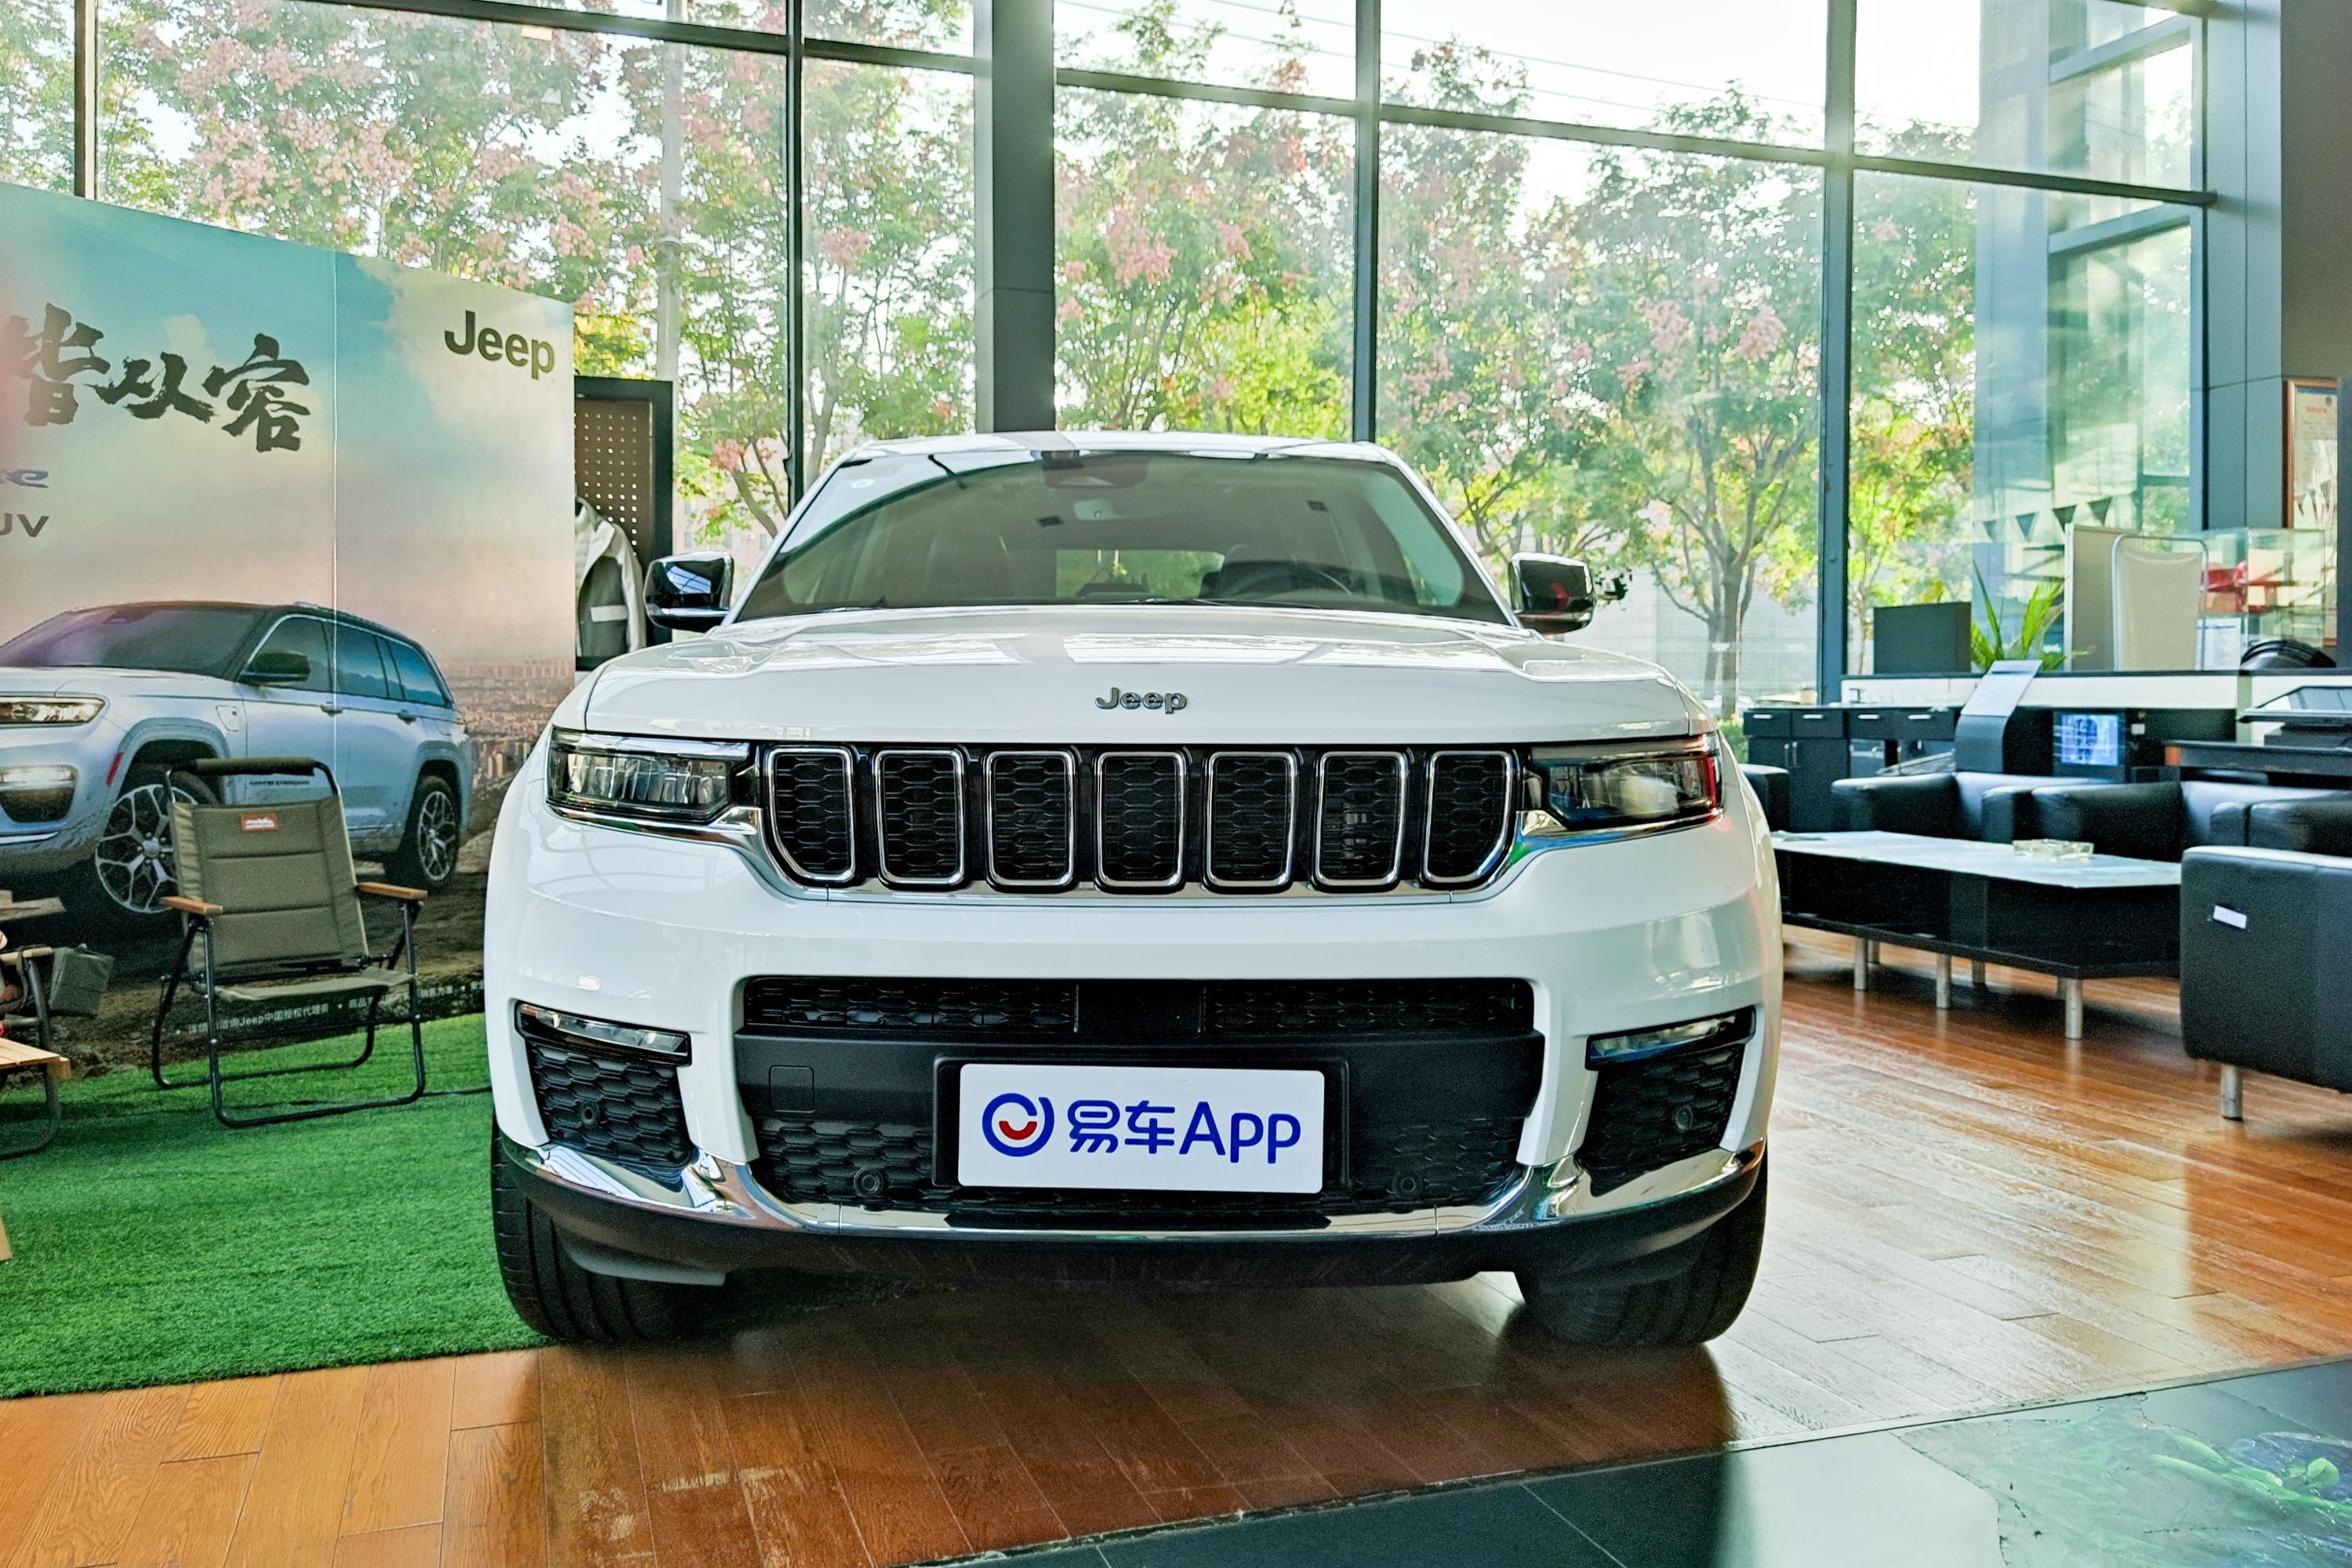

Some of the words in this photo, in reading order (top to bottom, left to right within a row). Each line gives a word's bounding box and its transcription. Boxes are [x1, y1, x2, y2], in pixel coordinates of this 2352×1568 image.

[445, 310, 555, 380] Jeep
[1095, 687, 1187, 714] Jeep
[1066, 1099, 1301, 1164] 易车App
